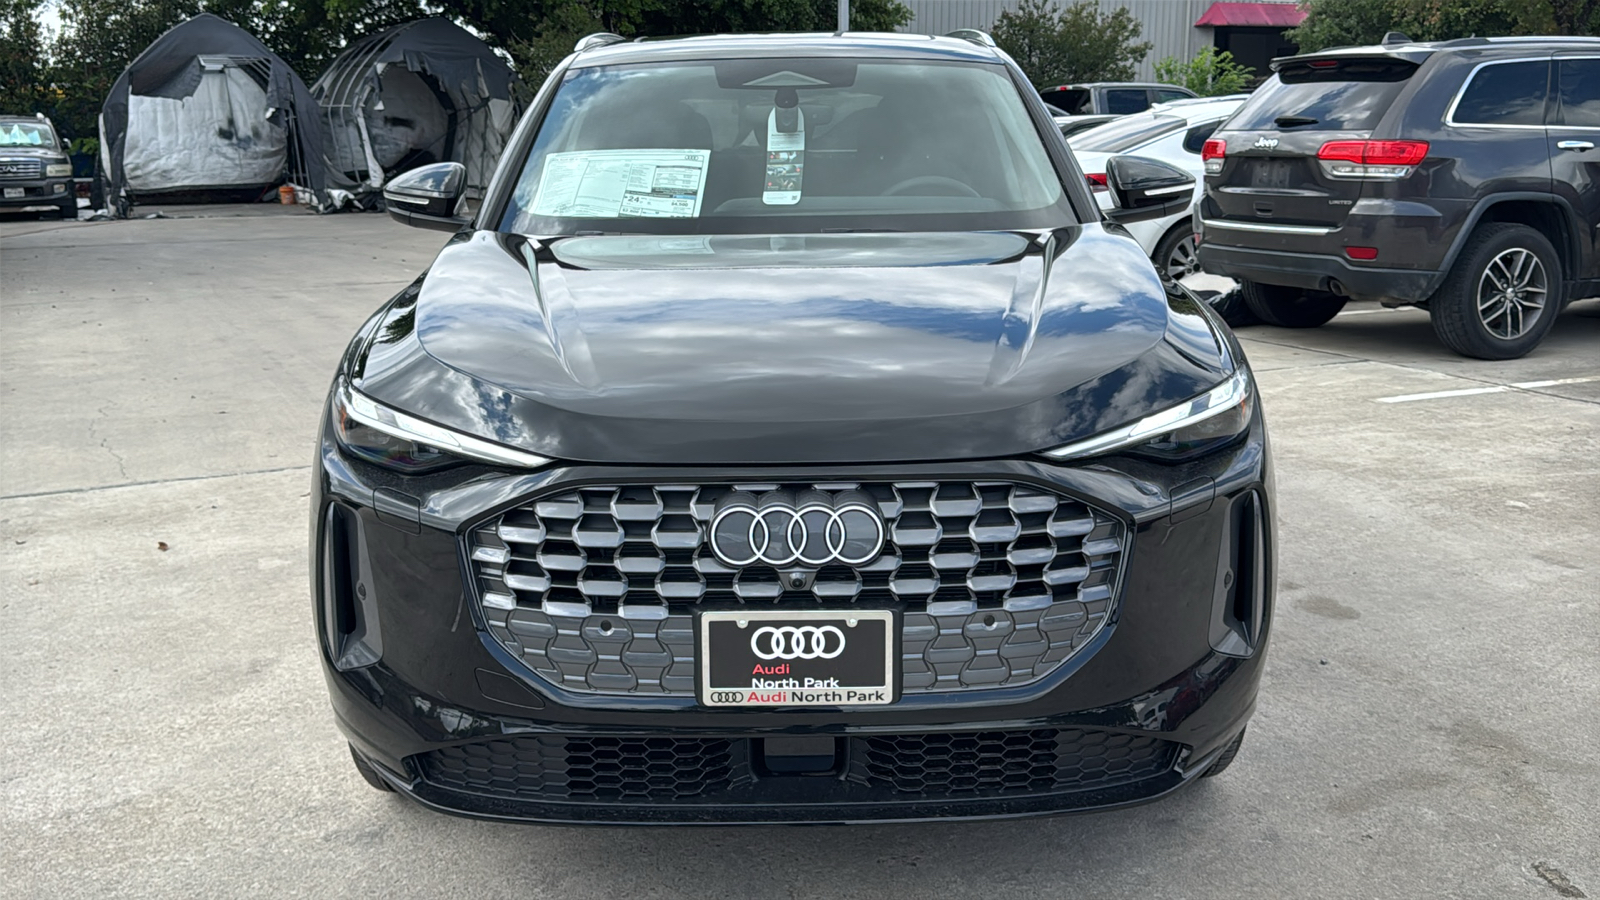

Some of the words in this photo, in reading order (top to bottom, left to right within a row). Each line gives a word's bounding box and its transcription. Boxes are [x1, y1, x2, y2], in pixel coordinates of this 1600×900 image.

[1254, 137, 1279, 150] Jeep
[752, 663, 790, 675] Audi
[751, 678, 799, 689] North
[804, 677, 840, 688] Park
[747, 691, 787, 703] Audi
[791, 691, 842, 703] North
[846, 690, 885, 702] Park
